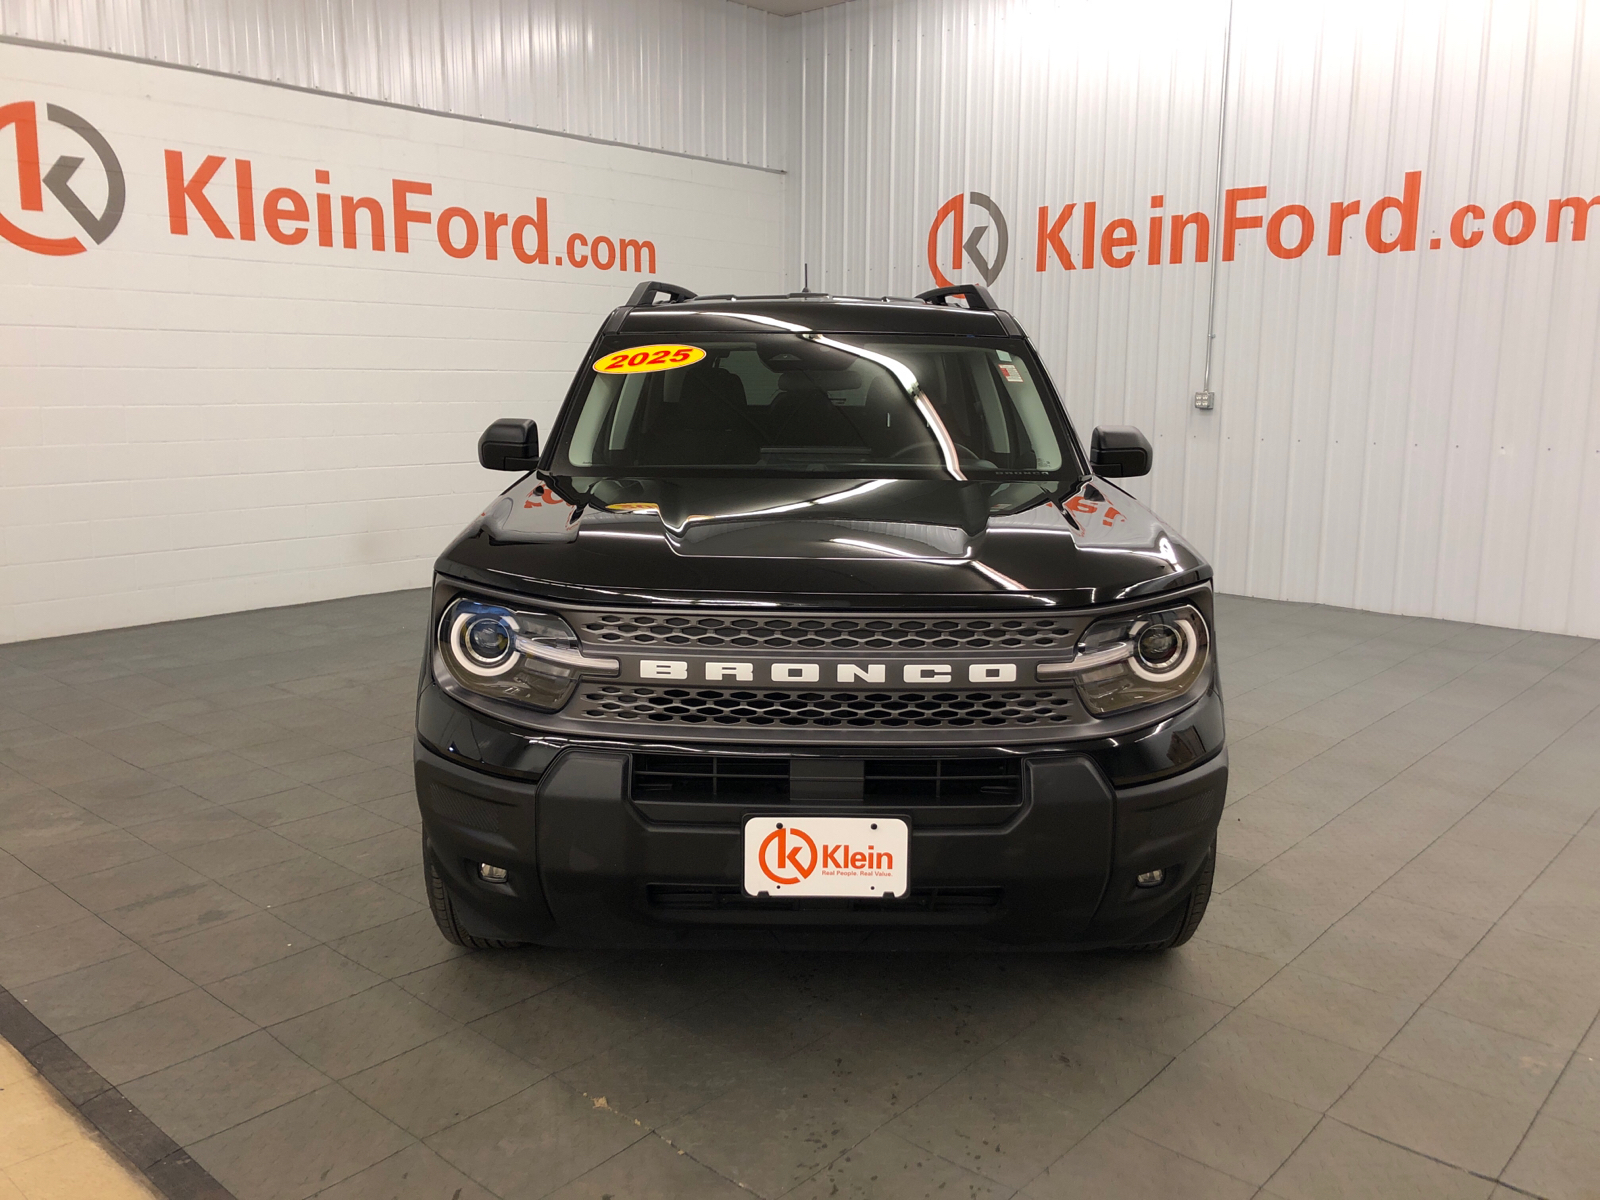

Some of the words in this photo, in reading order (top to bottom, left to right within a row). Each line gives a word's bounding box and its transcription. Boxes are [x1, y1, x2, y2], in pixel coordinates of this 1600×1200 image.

[165, 149, 656, 274] KleinFord.com
[1036, 171, 1600, 272] KleinFord.com
[604, 349, 694, 370] 2025
[640, 661, 1017, 683] BRONCO
[822, 844, 893, 869] Klein
